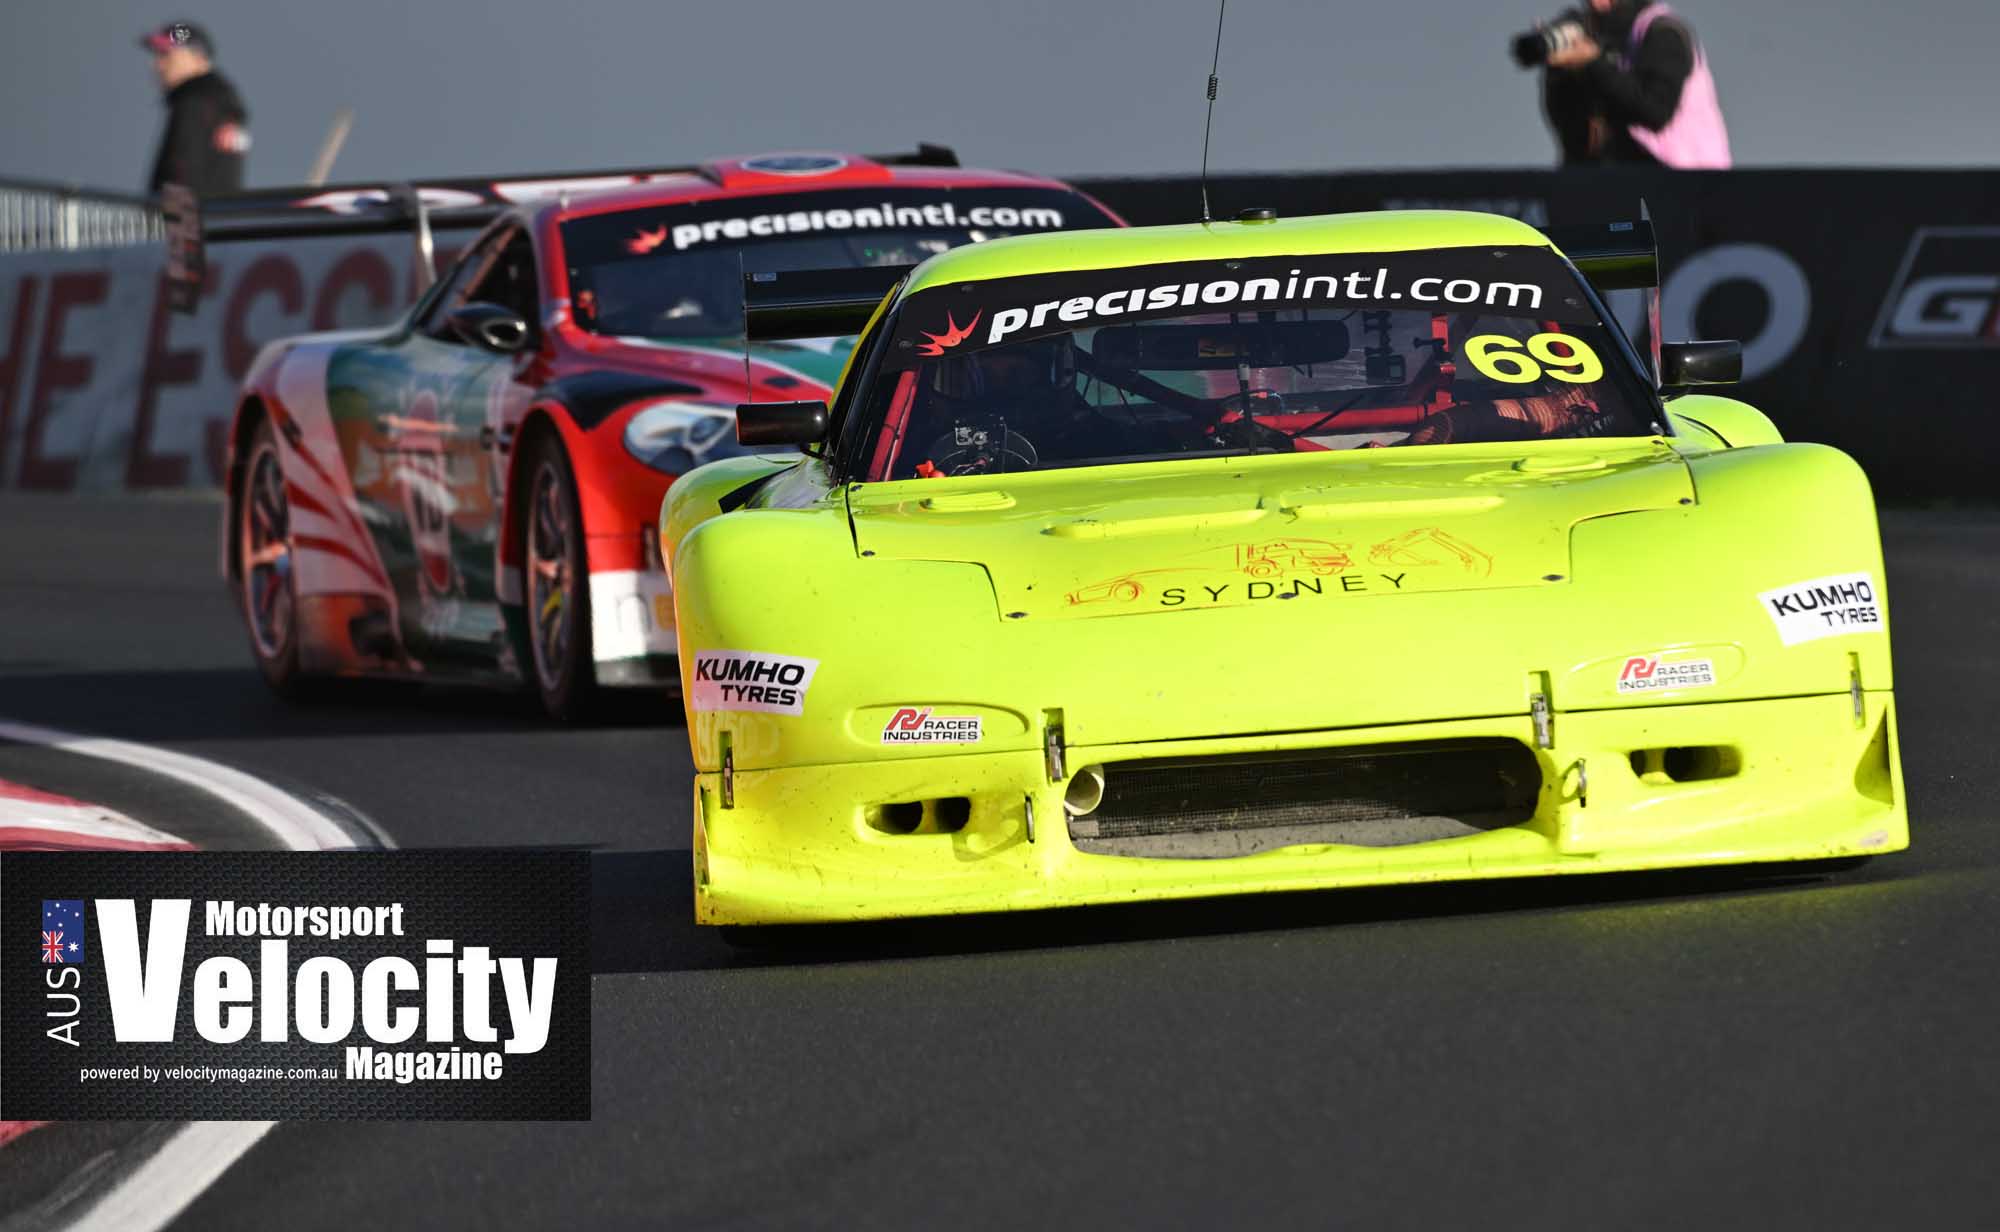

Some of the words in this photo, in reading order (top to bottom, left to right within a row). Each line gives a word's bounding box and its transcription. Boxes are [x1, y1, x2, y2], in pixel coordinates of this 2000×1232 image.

[673, 203, 1063, 250] precisionintl.com
[987, 268, 1543, 344] precisionintl.com
[1464, 332, 1604, 384] 69
[1159, 572, 1407, 607] SYDNEY
[1772, 581, 1872, 616] KUMHO
[1820, 606, 1878, 627] TYRES
[696, 658, 805, 686] KUMHO
[1619, 674, 1712, 689] INDUSTRIES
[1657, 663, 1709, 675] RACER
[720, 684, 797, 706] TYRES
[883, 731, 978, 741] INDUSTRIES
[923, 720, 978, 730] RACER
